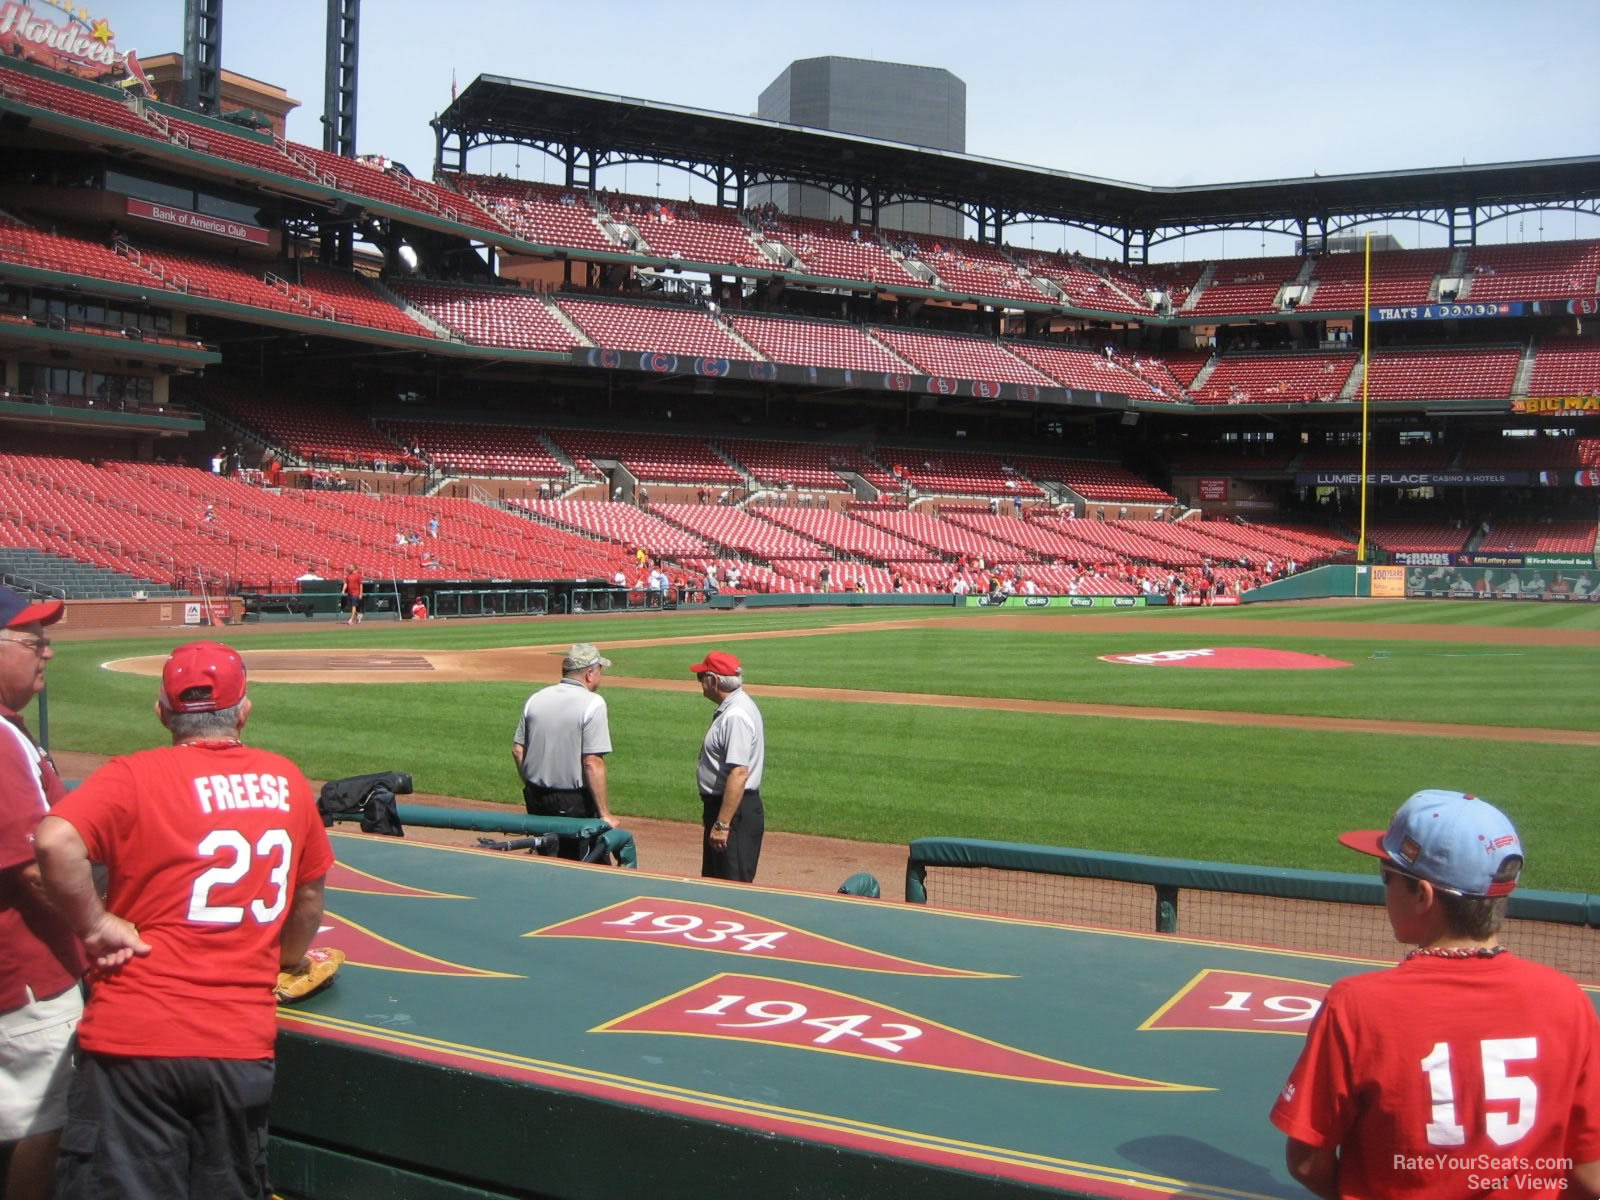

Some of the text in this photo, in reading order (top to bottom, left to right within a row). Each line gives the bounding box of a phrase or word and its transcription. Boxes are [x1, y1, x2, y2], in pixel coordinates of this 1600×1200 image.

[152, 207, 247, 238] Bank of America Club
[1379, 308, 1417, 320] THAT'S
[1423, 307, 1432, 318] A
[1439, 304, 1497, 316] POWER
[1527, 398, 1560, 413] BIG
[1381, 474, 1428, 484] PLACE
[195, 773, 290, 814] FREESE
[187, 828, 292, 923] 23
[602, 911, 788, 951] 1934
[685, 995, 923, 1052] 1942
[1421, 1037, 1538, 1145] 15
